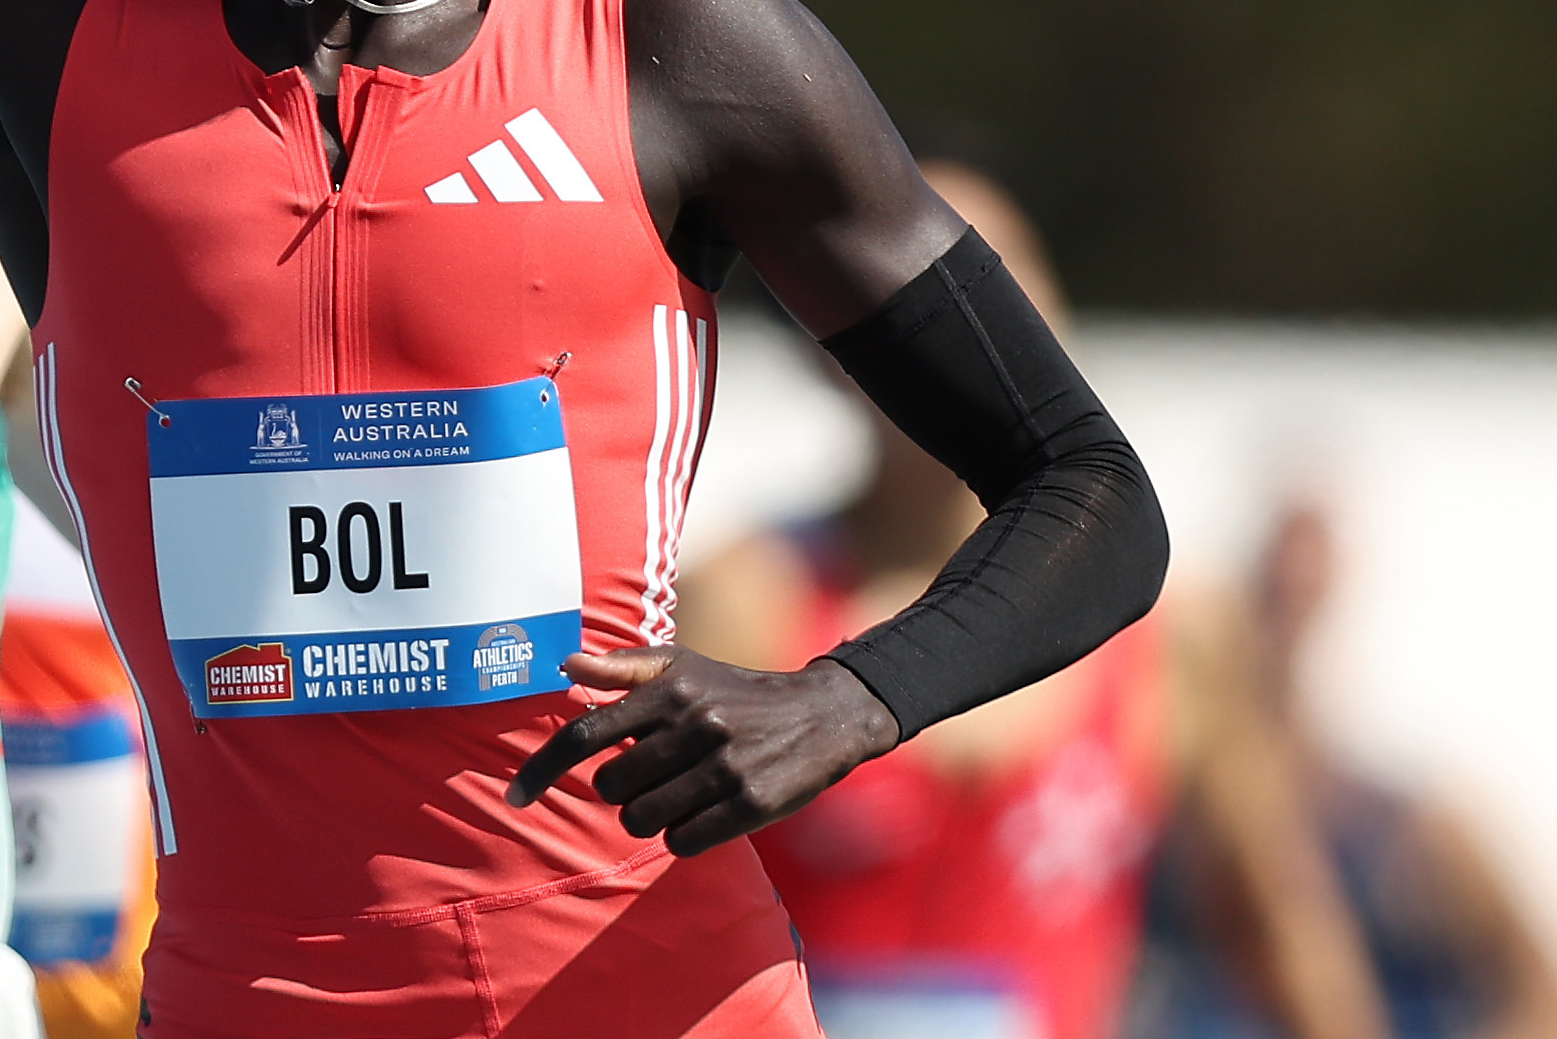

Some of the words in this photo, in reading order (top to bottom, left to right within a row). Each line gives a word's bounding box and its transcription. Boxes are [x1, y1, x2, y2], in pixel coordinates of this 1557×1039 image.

[341, 400, 458, 420] WESTERN
[332, 422, 469, 442] AUSTRALIA
[333, 450, 391, 461] WALKING
[392, 449, 411, 459] ON
[412, 448, 423, 458] A
[425, 445, 470, 457] DREAM
[288, 500, 430, 596] BOL
[301, 638, 450, 678] CHEMIST
[473, 641, 534, 669] ATHLETICS
[209, 663, 286, 684] CHEMIST
[492, 670, 518, 687] PERTH
[211, 683, 285, 696] WAREHOUSE
[304, 674, 448, 699] WAREHOUSE
